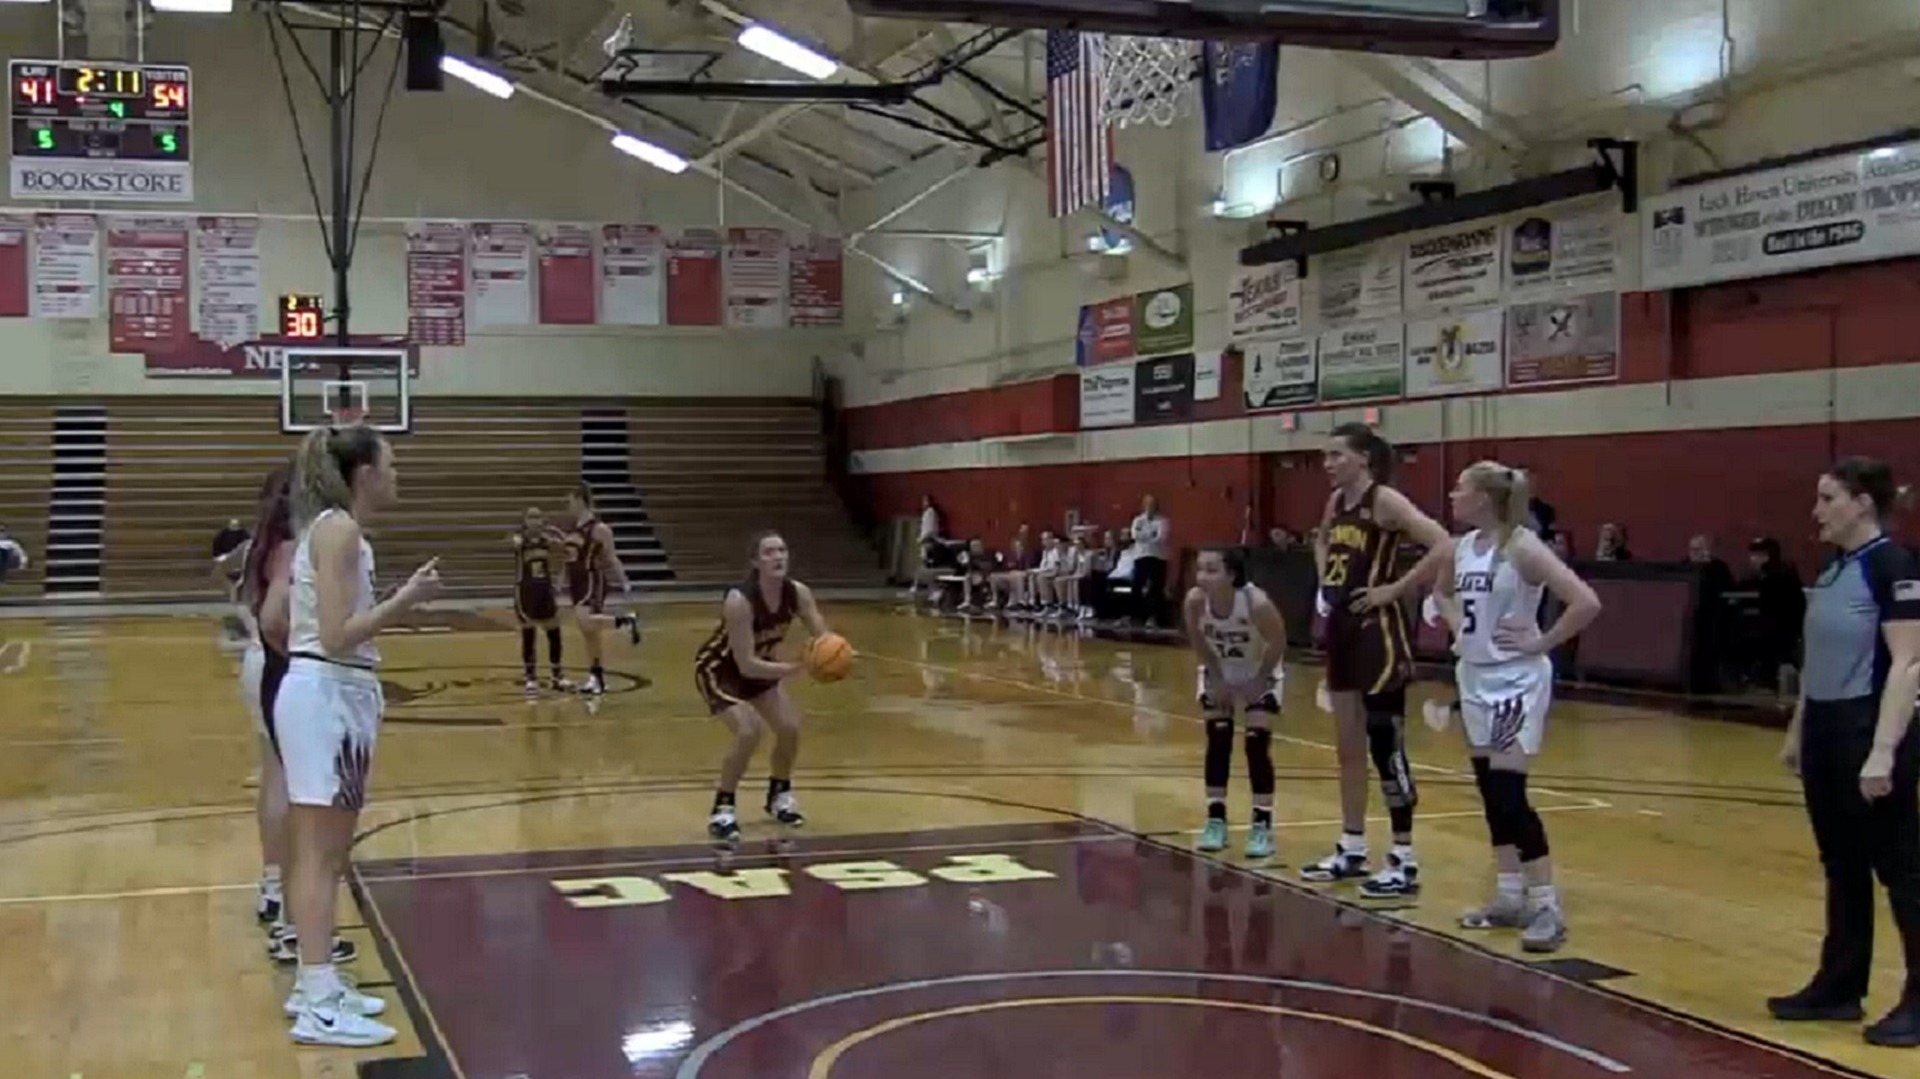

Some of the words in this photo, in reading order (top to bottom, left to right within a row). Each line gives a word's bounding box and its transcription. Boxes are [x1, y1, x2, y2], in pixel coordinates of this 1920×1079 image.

[21, 79, 53, 104] 41
[76, 67, 139, 93] 2:11
[153, 83, 185, 107] 54
[110, 101, 124, 118] 4
[37, 129, 54, 149] 5
[161, 134, 177, 152] 5
[21, 170, 183, 193] BOOKSTORE
[286, 312, 318, 337] 30
[1321, 553, 1350, 587] 25
[1462, 599, 1477, 634] 5
[551, 854, 1057, 909] PSAC
